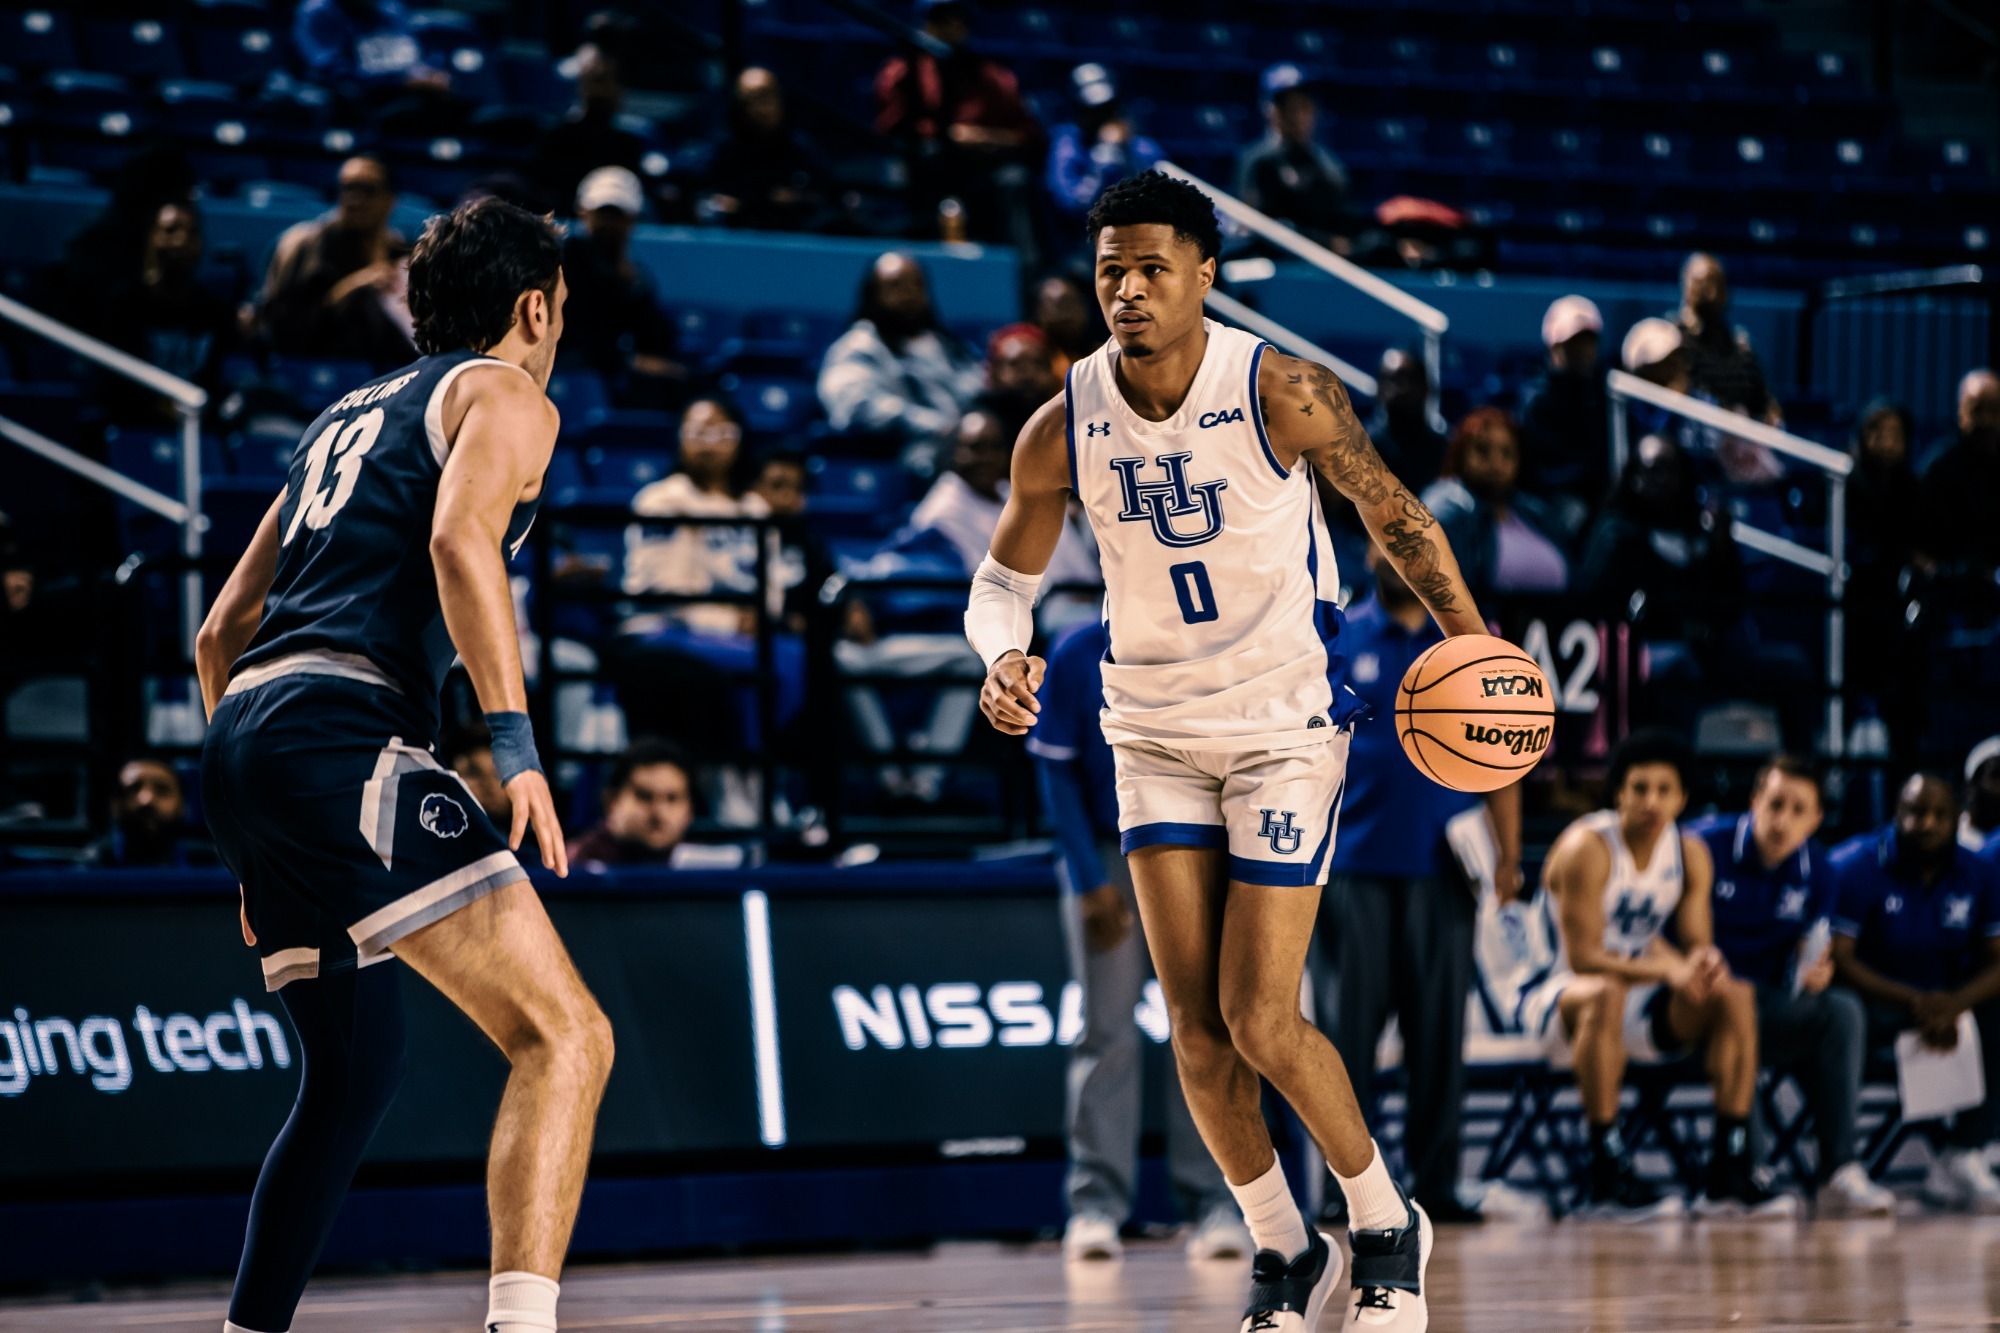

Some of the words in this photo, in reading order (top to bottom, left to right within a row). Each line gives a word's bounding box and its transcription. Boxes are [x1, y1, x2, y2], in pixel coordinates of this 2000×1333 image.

[1199, 408, 1245, 429] CAA
[282, 407, 384, 548] 13
[1110, 451, 1228, 548] HU
[1169, 561, 1219, 625] 0
[1481, 675, 1543, 698] NCAA
[1465, 722, 1550, 755] Wilson
[1257, 808, 1306, 855] HU
[133, 998, 291, 1072] tech
